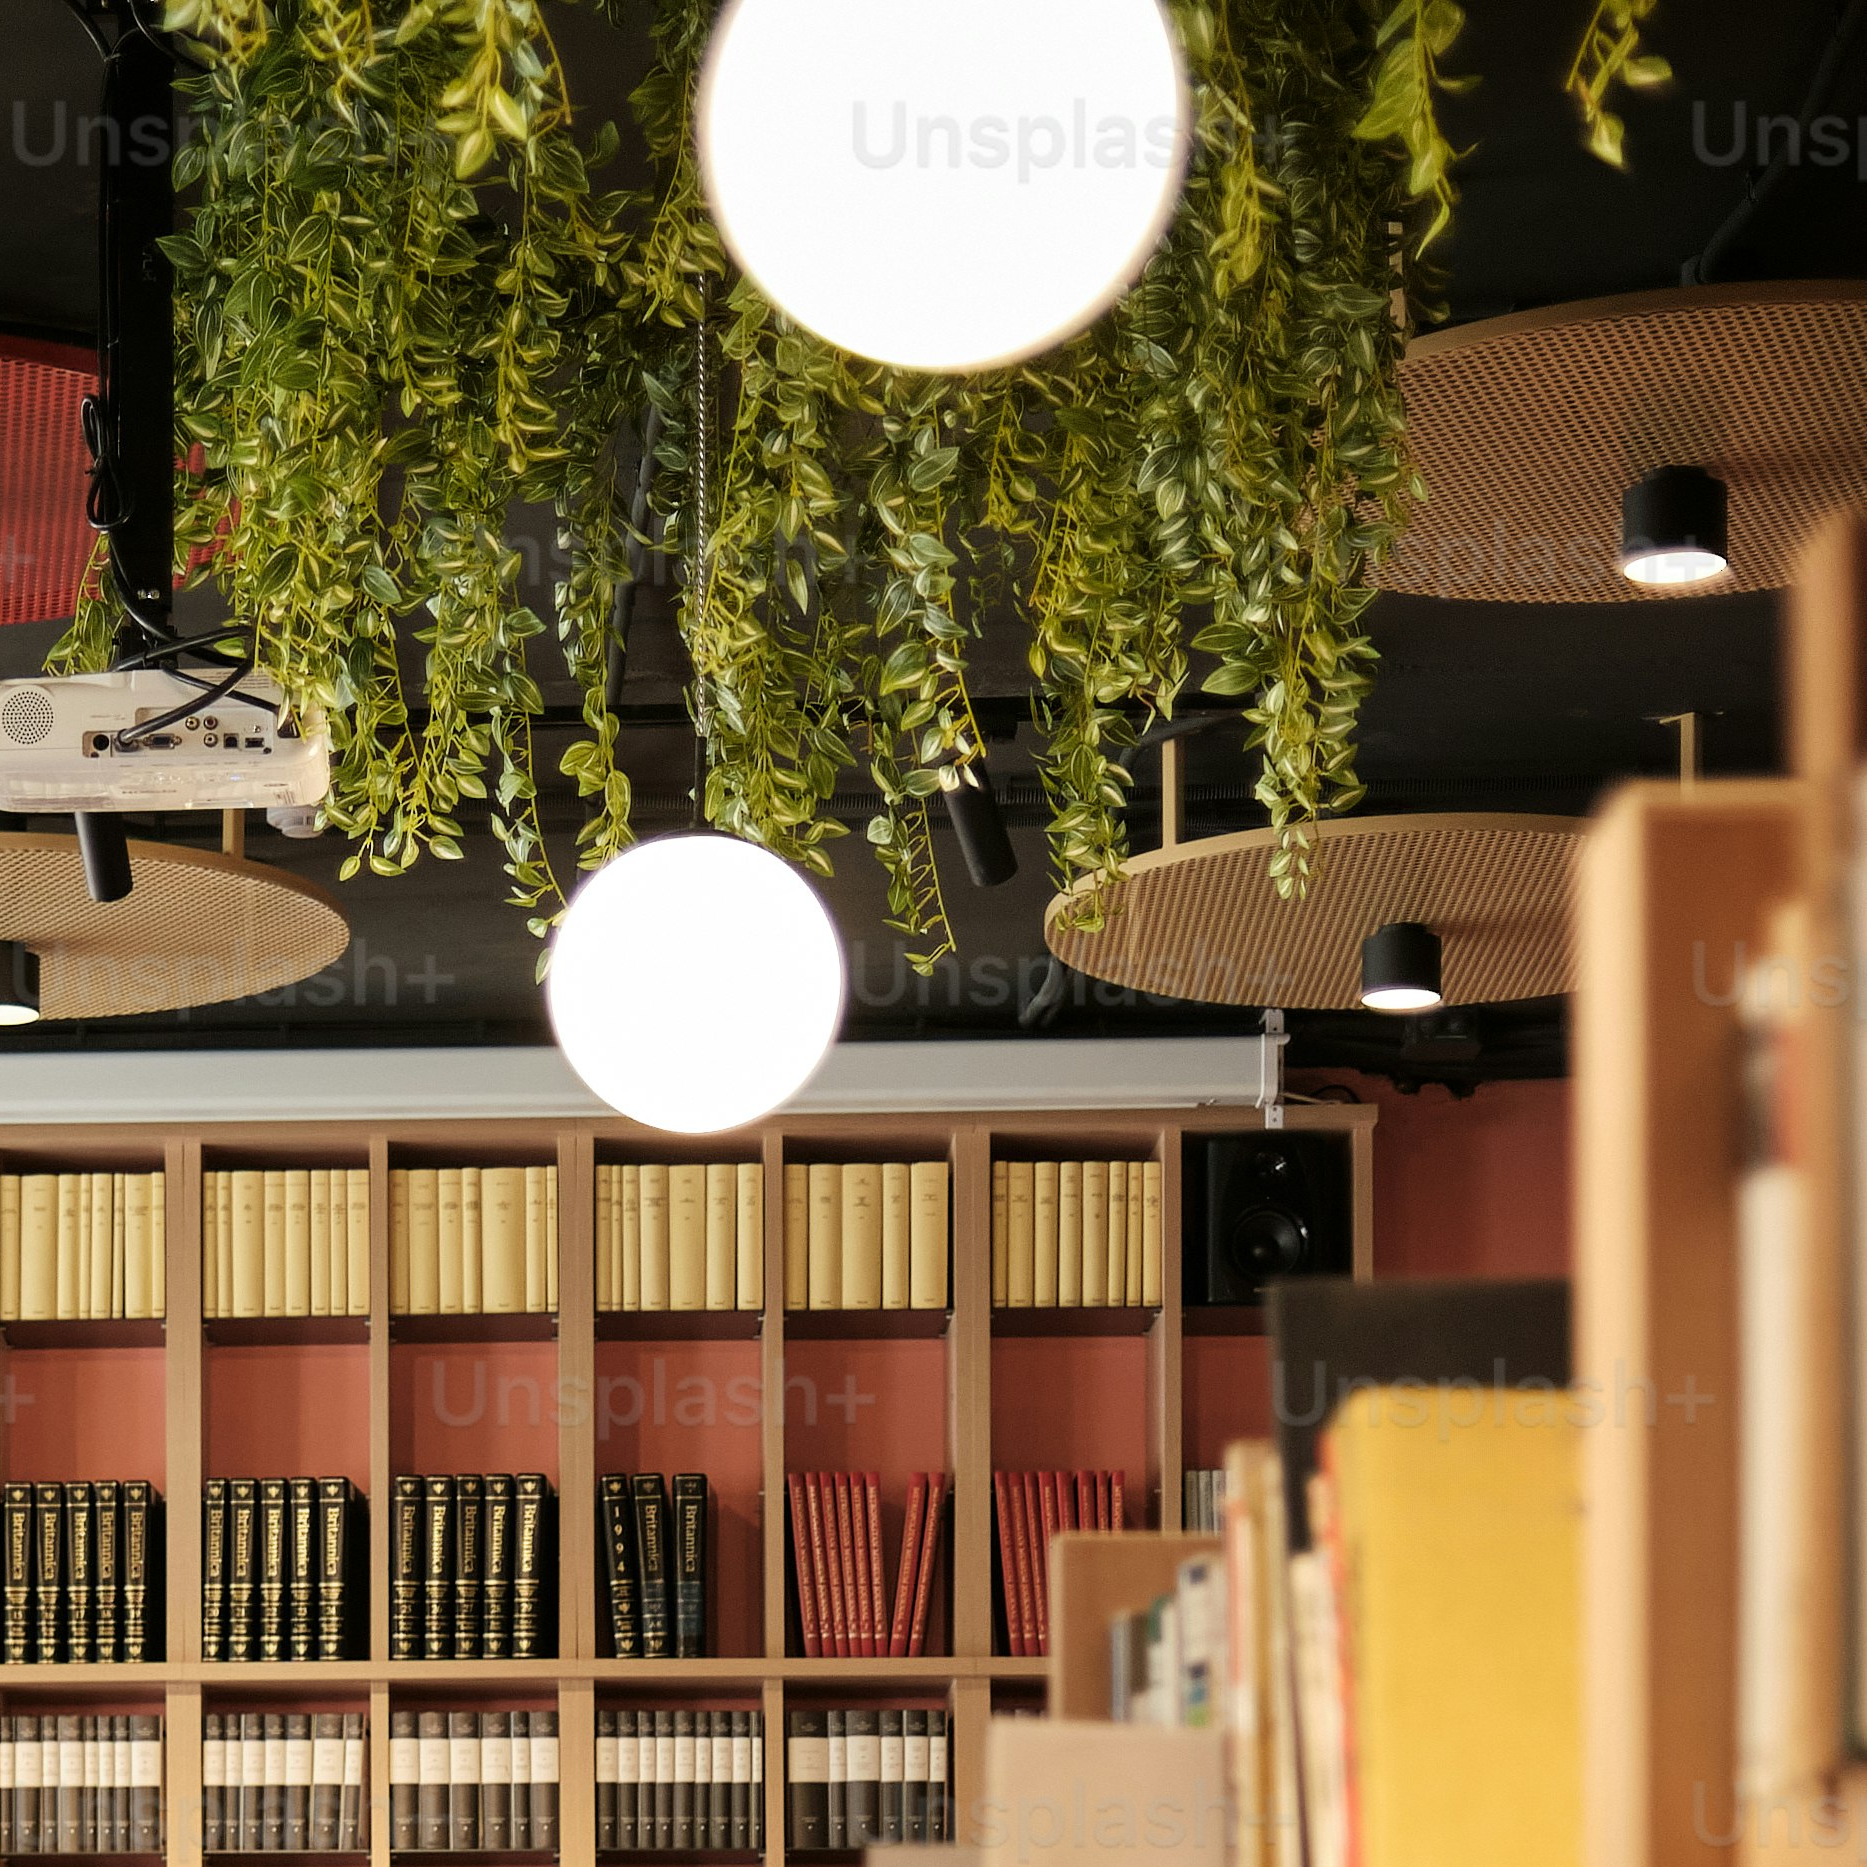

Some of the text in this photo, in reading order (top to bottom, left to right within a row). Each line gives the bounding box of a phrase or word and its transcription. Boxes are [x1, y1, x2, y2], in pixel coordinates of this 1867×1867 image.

[13, 1512, 25, 1580] Britannica
[44, 1512, 56, 1580] Britannica
[74, 1512, 86, 1580] Britannica
[102, 1512, 114, 1579] Britannica
[131, 1512, 143, 1578] Britannica
[210, 1510, 222, 1577] Britannica
[236, 1510, 250, 1577] Britannica
[268, 1510, 280, 1577] Britannica
[297, 1508, 310, 1576] Britannica
[326, 1507, 340, 1576] Britannica
[402, 1506, 415, 1574] Britannica
[432, 1506, 446, 1574] Britannica
[464, 1506, 476, 1573] Britannica
[492, 1506, 505, 1573] Britannica
[522, 1504, 536, 1572] Britannica
[646, 1504, 658, 1572] Britannica
[686, 1505, 698, 1572] Britannica
